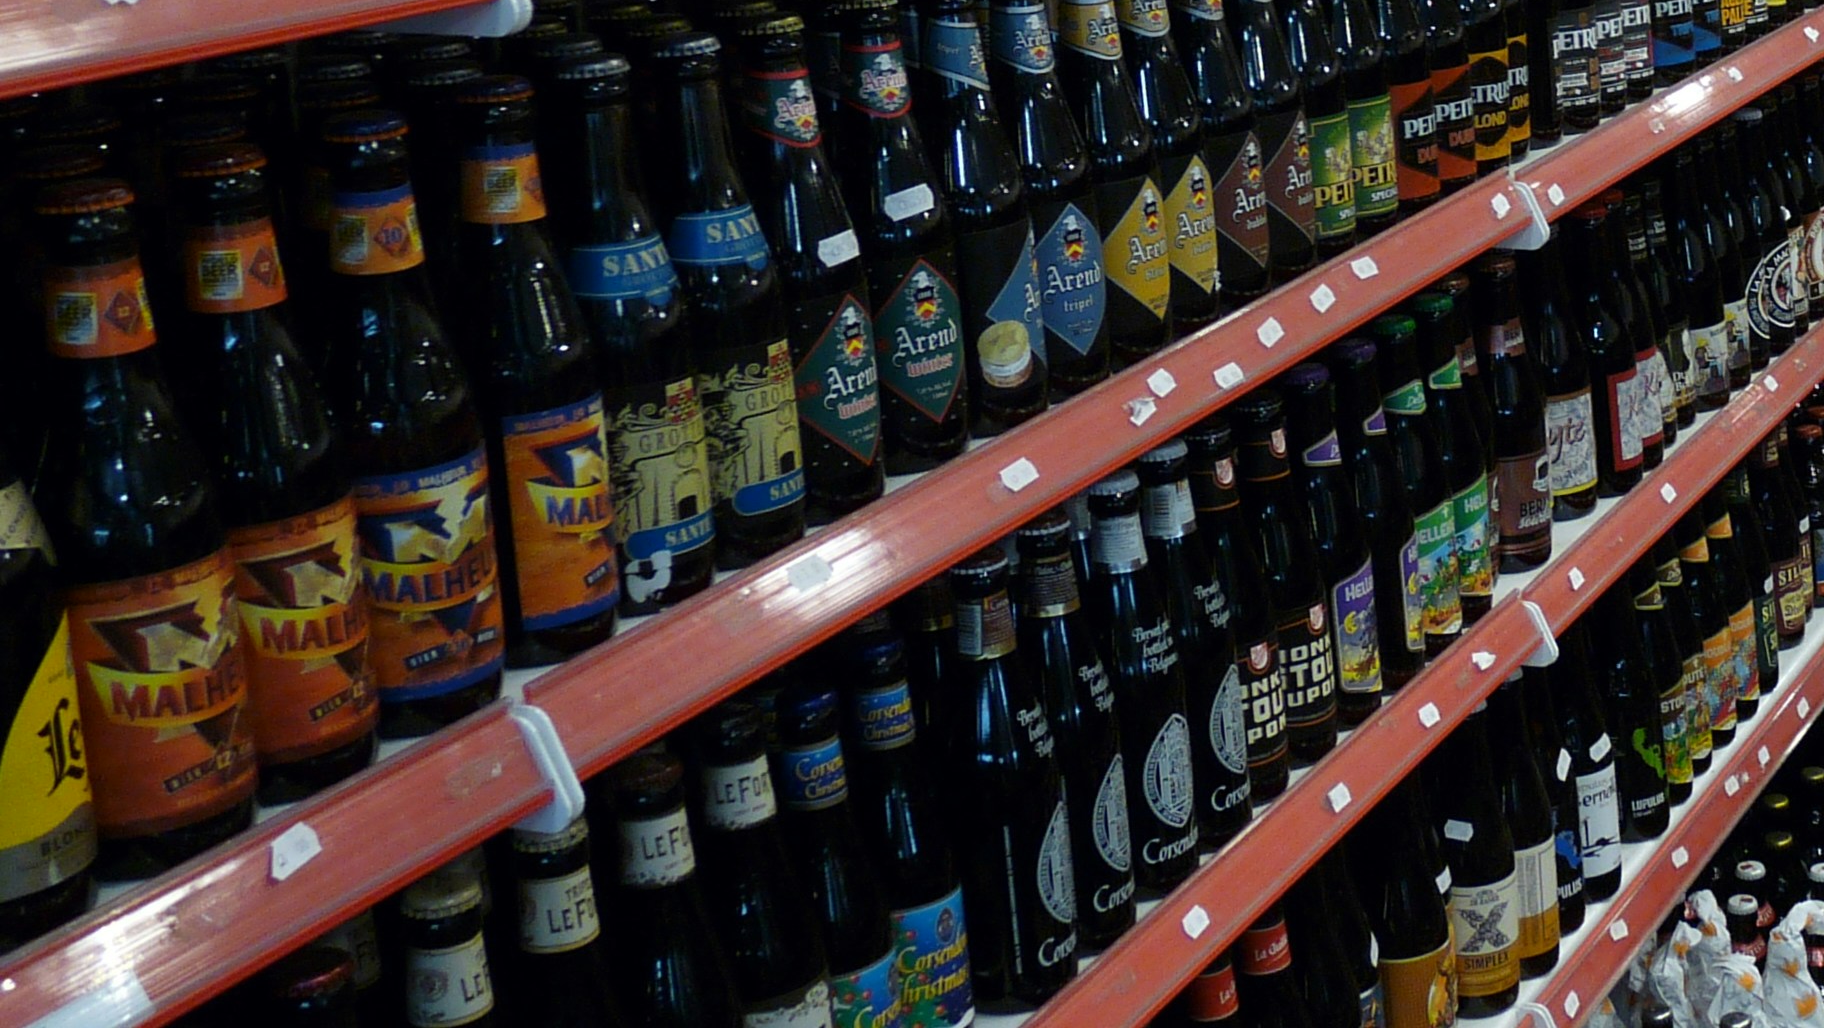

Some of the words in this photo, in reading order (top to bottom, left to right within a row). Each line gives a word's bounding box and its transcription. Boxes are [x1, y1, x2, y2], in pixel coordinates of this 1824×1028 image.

[1043, 264, 1102, 304] Arend
[1063, 293, 1094, 315] tripel
[892, 316, 959, 370] Arend
